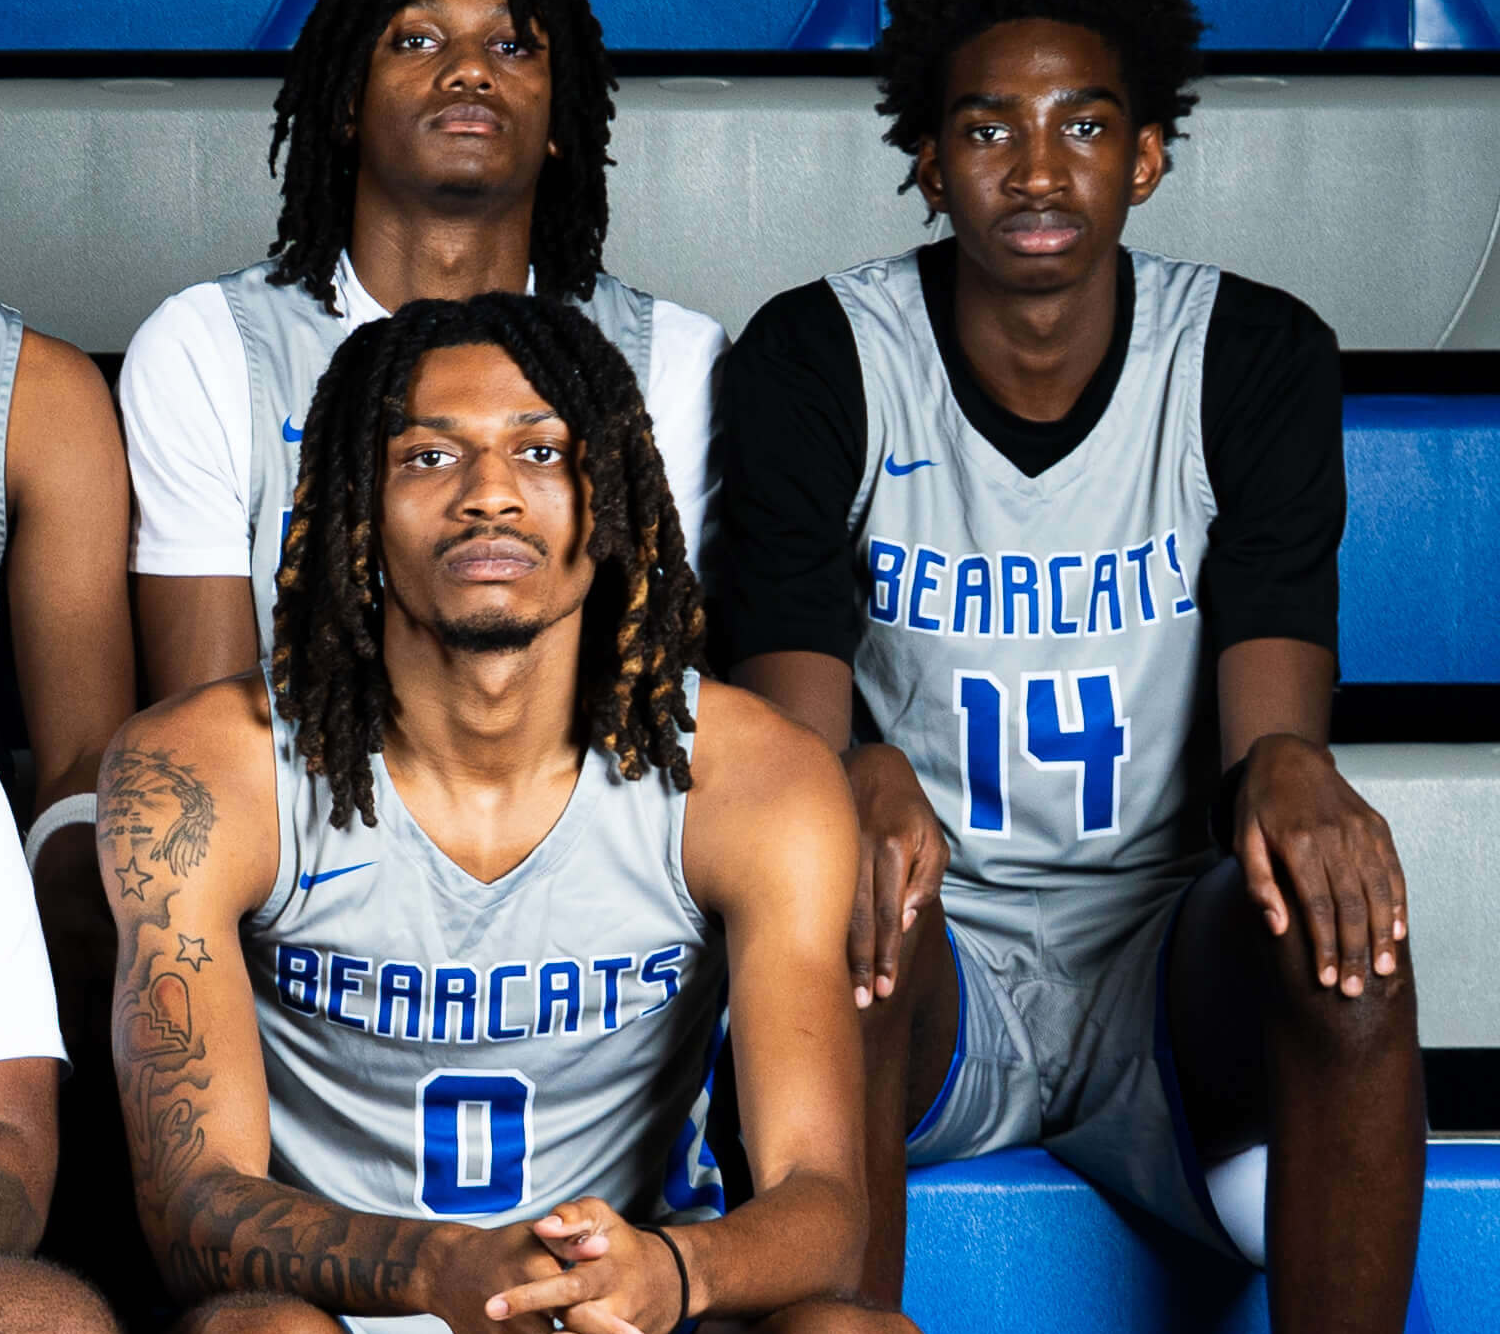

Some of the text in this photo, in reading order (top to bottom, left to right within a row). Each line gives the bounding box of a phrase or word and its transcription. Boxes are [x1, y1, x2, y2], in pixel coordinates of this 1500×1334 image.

[867, 529, 1198, 640] BEARCATS
[953, 667, 1131, 839] 14
[273, 942, 687, 1044] BEARCATS
[412, 1067, 536, 1219] 0
